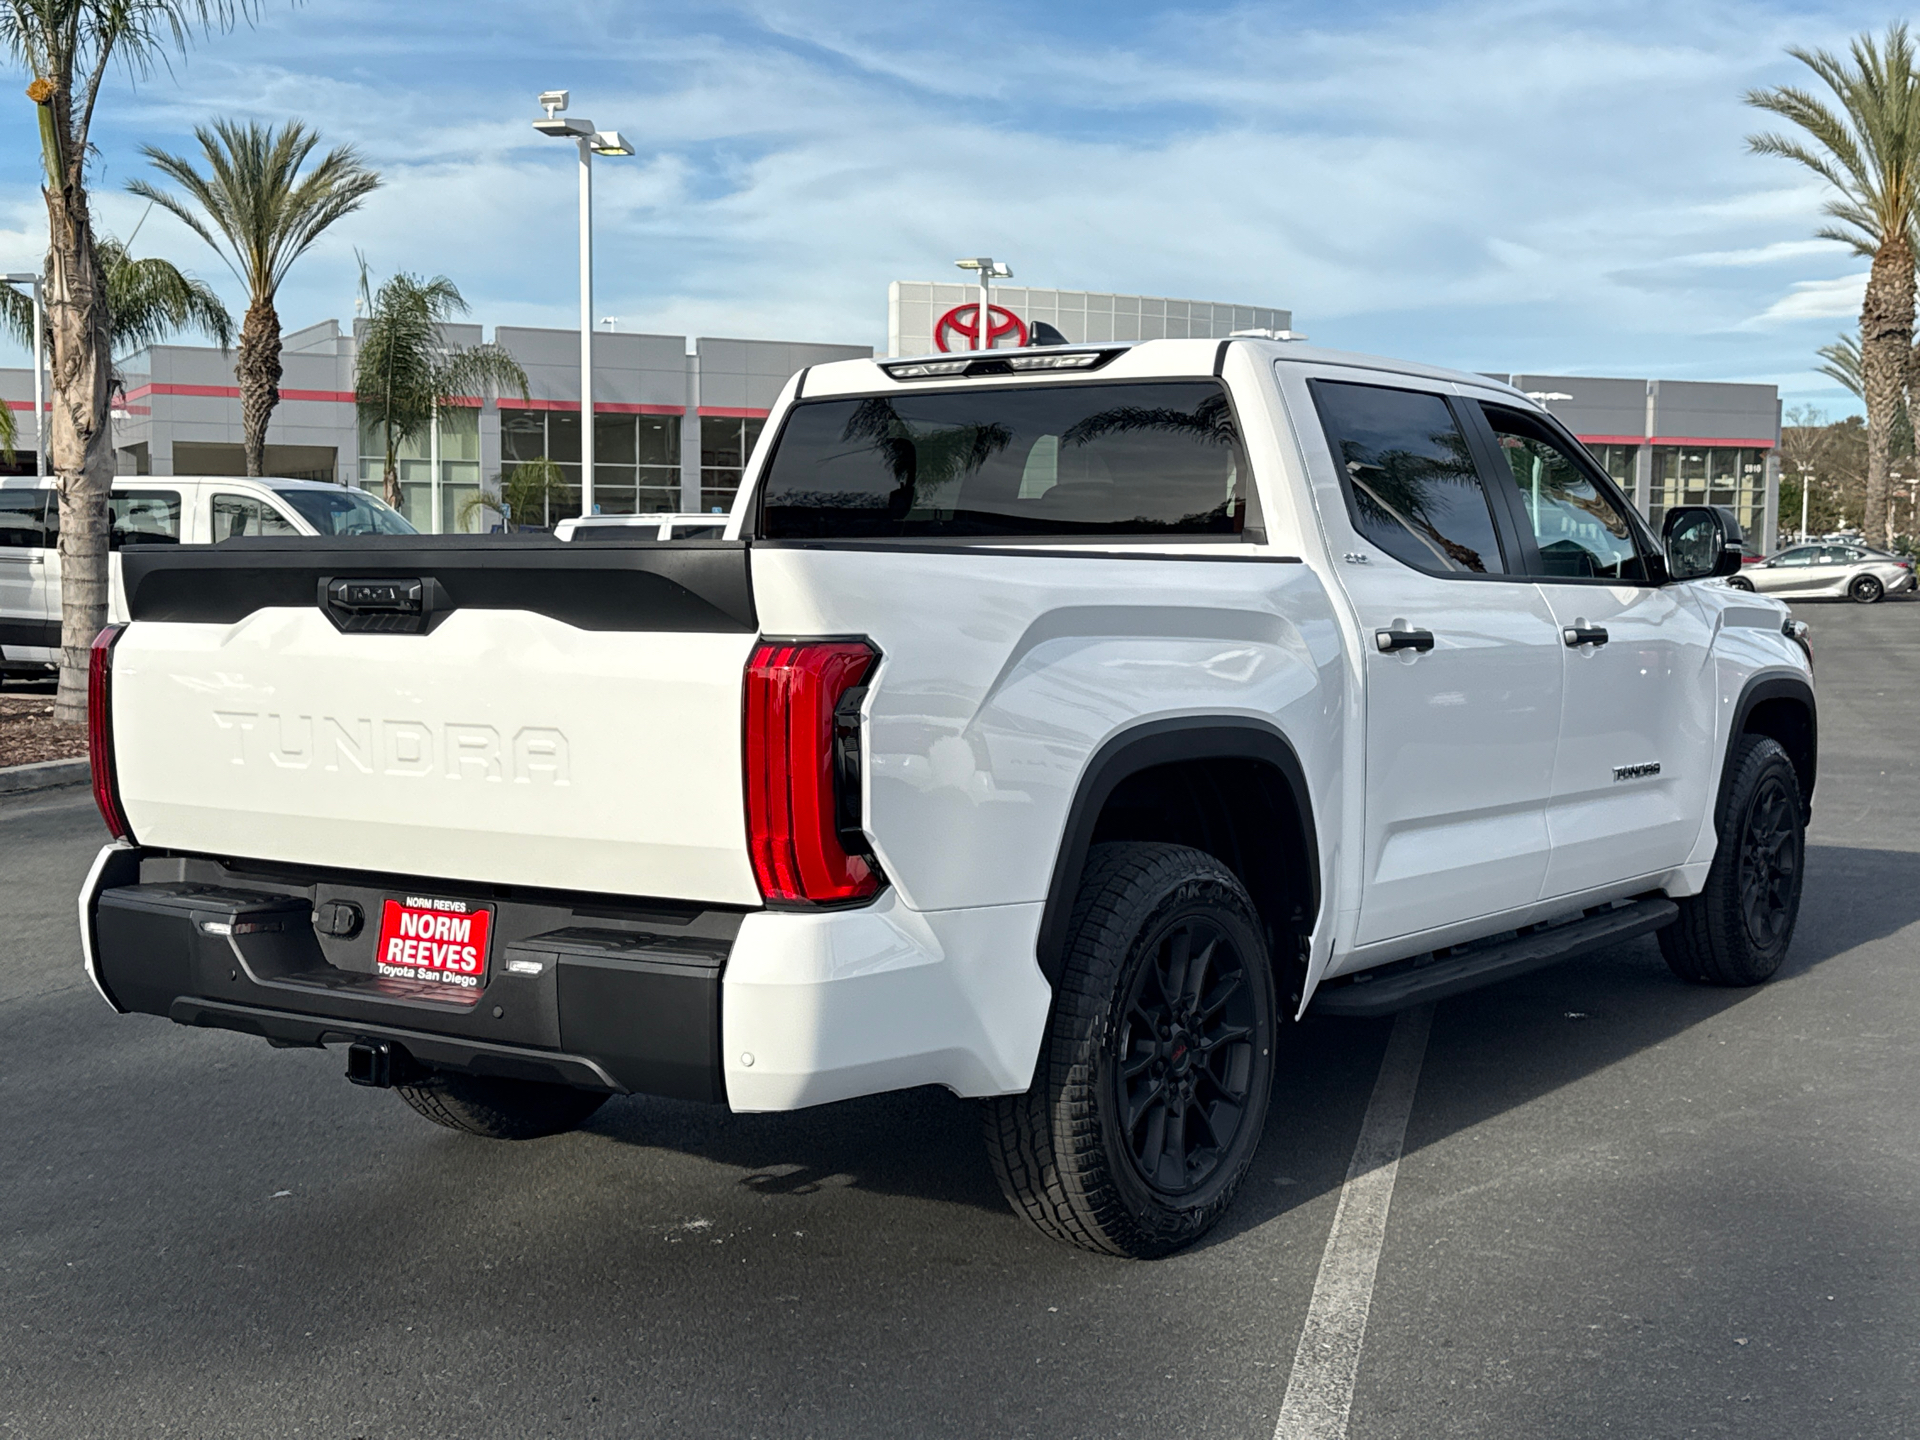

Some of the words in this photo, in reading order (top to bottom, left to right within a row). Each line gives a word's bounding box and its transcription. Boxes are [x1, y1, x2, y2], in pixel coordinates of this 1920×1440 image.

[212, 710, 571, 787] TUNDRA
[1612, 761, 1661, 782] TUNDRA
[406, 896, 432, 909] NORM
[433, 900, 467, 912] REEVES
[400, 912, 471, 943] NORM
[386, 937, 477, 971] REEVES
[377, 962, 415, 978] Toyota
[417, 967, 440, 981] San
[442, 970, 477, 988] Diego
